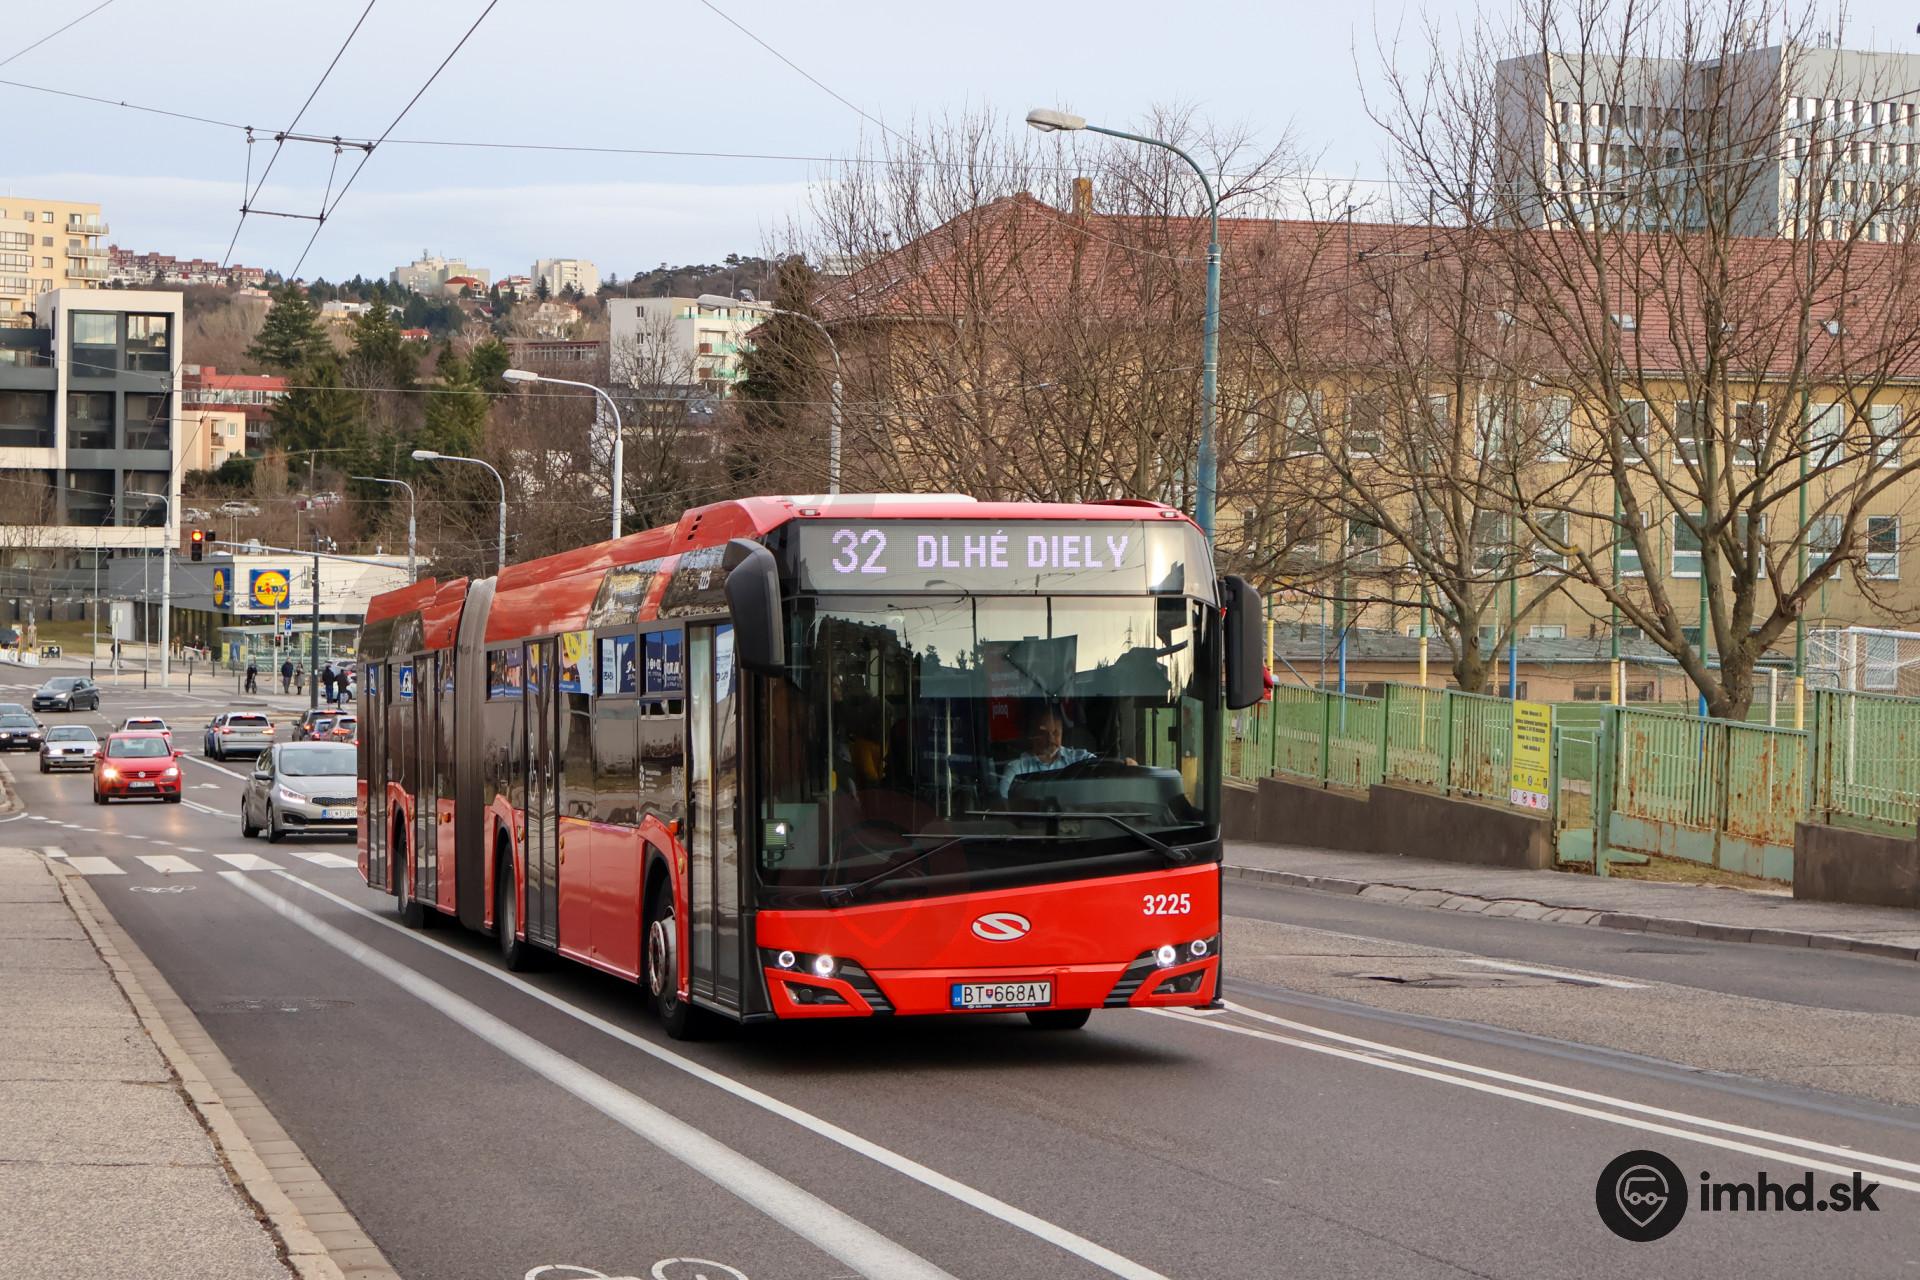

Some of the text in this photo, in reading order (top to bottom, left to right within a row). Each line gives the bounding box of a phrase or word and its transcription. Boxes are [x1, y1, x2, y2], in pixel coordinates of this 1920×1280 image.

[832, 529, 1128, 573] 32 DLHÉ DIELY
[257, 582, 286, 594] LIDL
[1143, 893, 1191, 915] 3225
